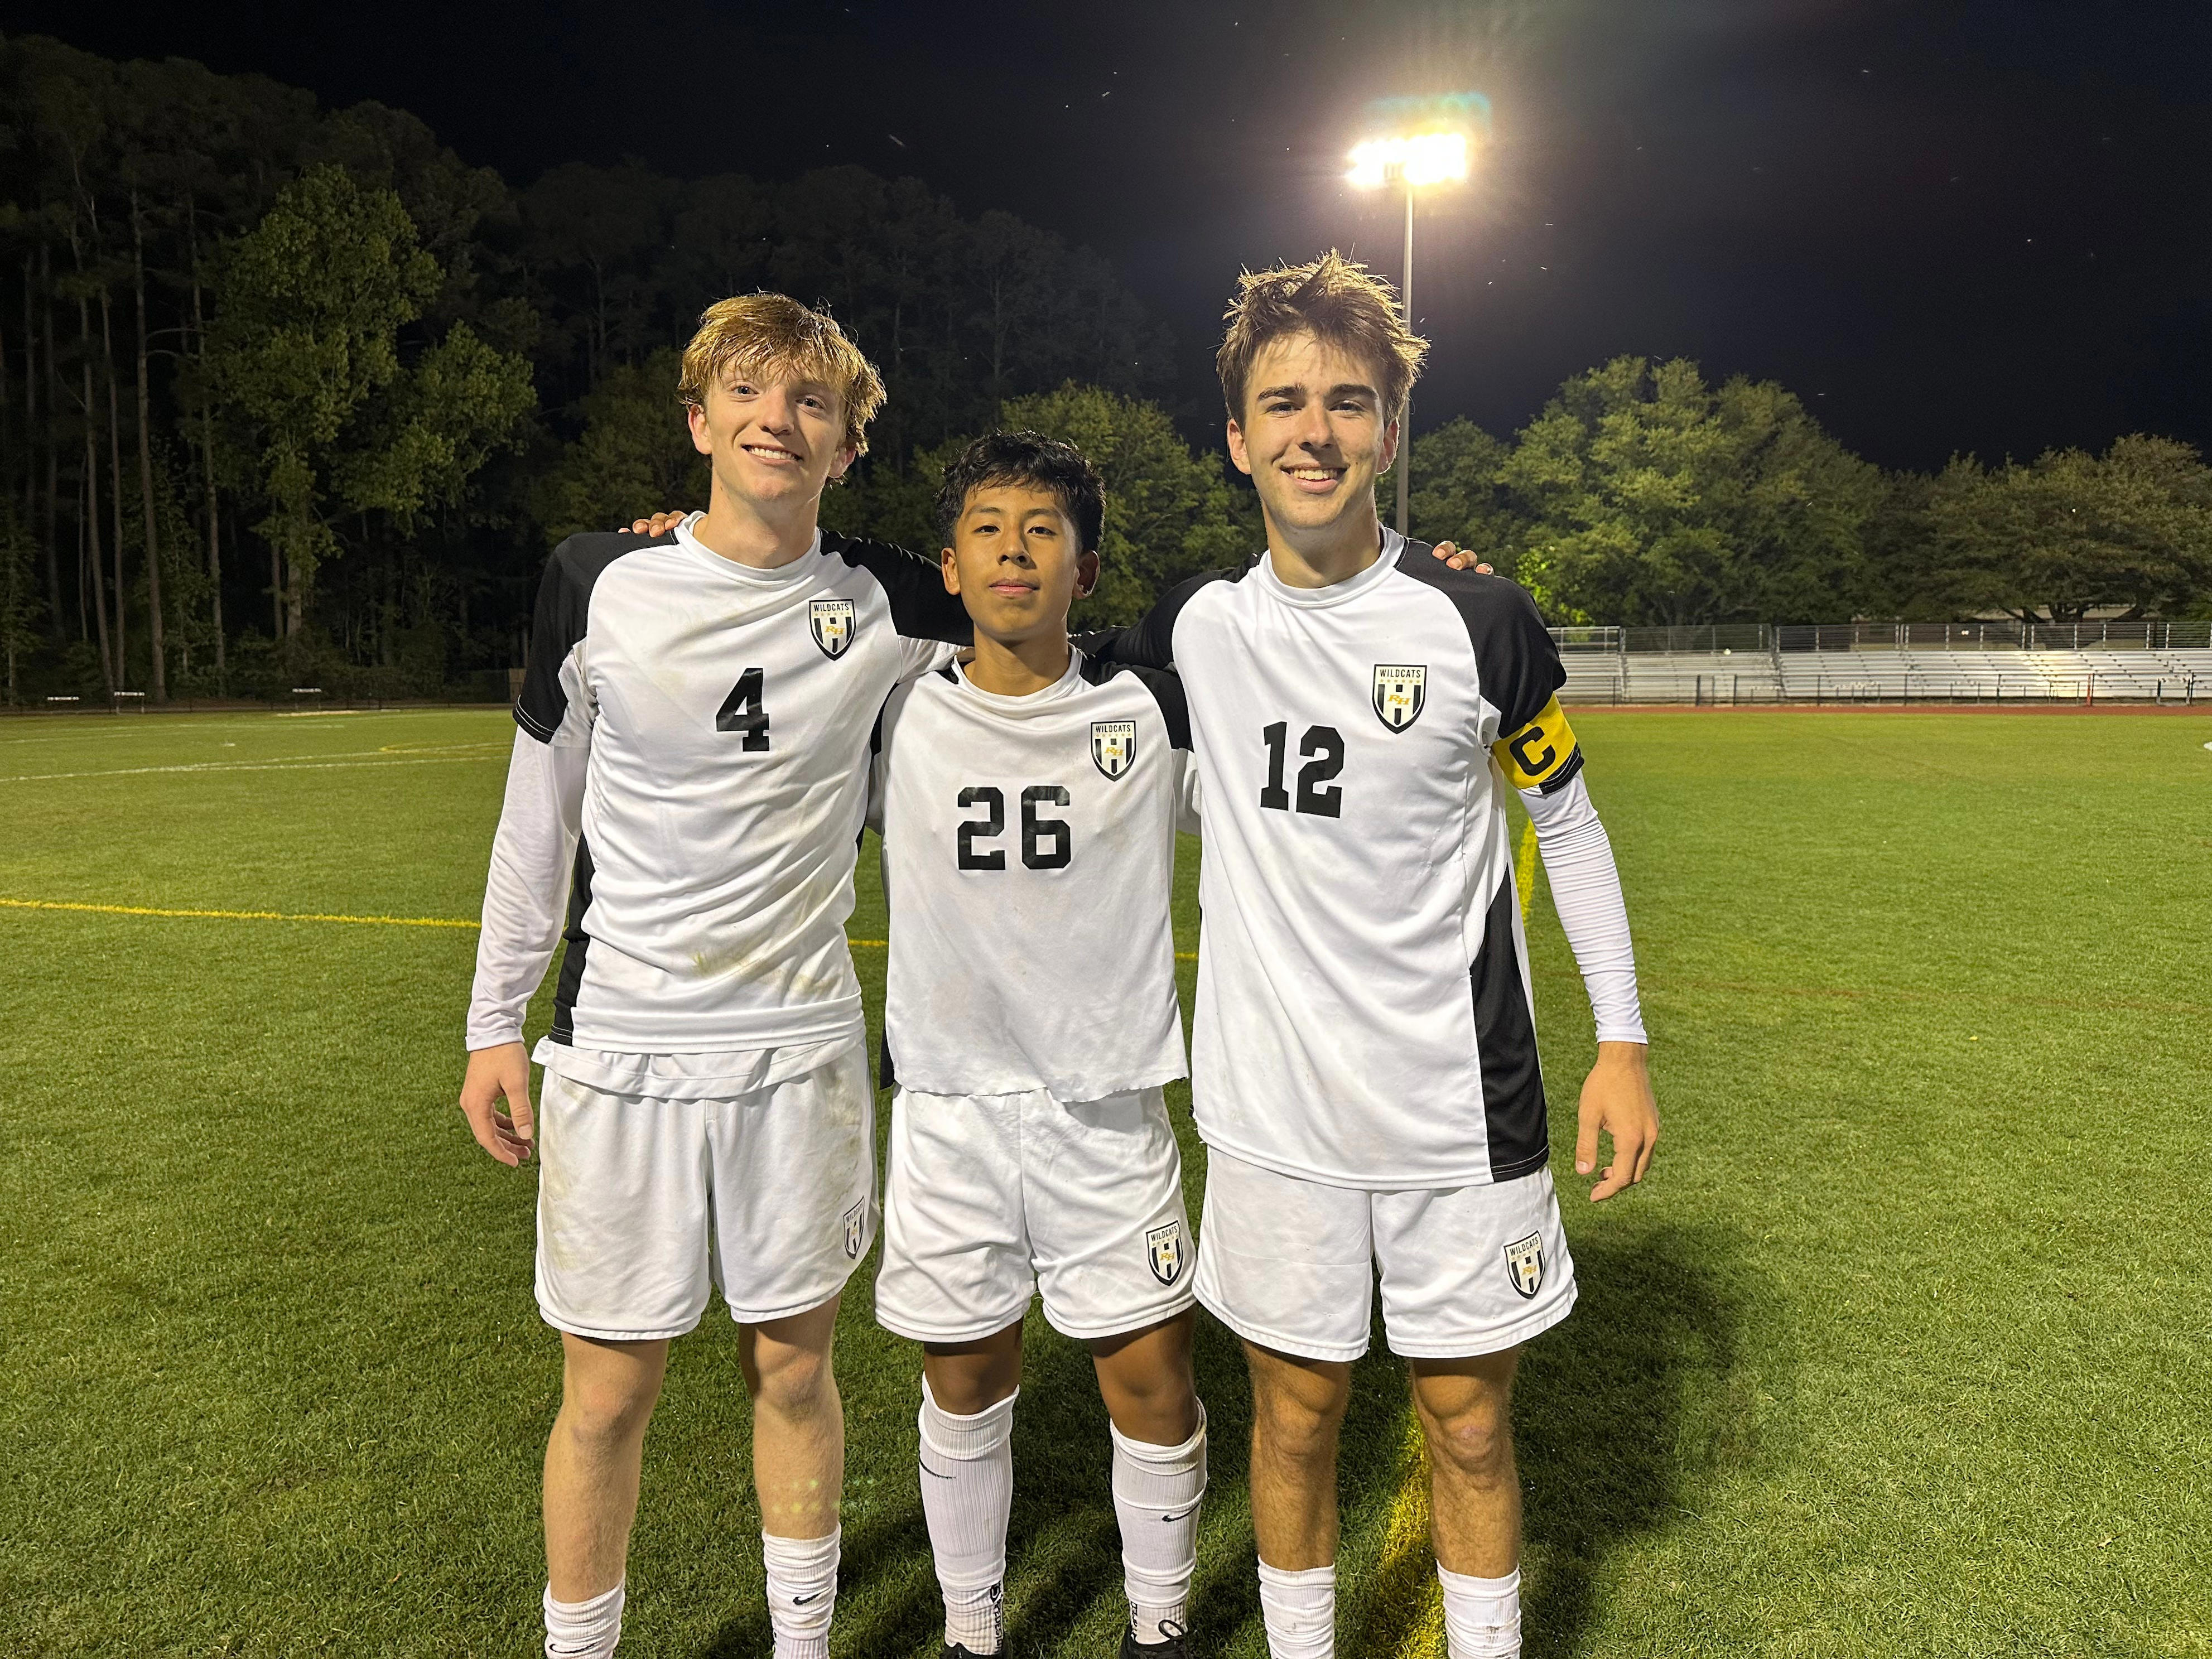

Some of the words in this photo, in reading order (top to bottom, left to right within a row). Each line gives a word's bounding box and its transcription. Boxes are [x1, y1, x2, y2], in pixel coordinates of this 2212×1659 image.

[814, 603, 849, 612] WILDCATS
[825, 626, 845, 635] RH
[1380, 669, 1421, 678] WILDCATS
[1387, 695, 1411, 705] RH
[716, 668, 770, 752] 4
[1105, 747, 1124, 756] RH
[1509, 726, 1556, 777] C
[1260, 721, 1344, 818] 12
[957, 785, 1071, 870] 26
[1151, 1226, 1178, 1242] WILDCATS
[1510, 1236, 1539, 1256] WILDCATS
